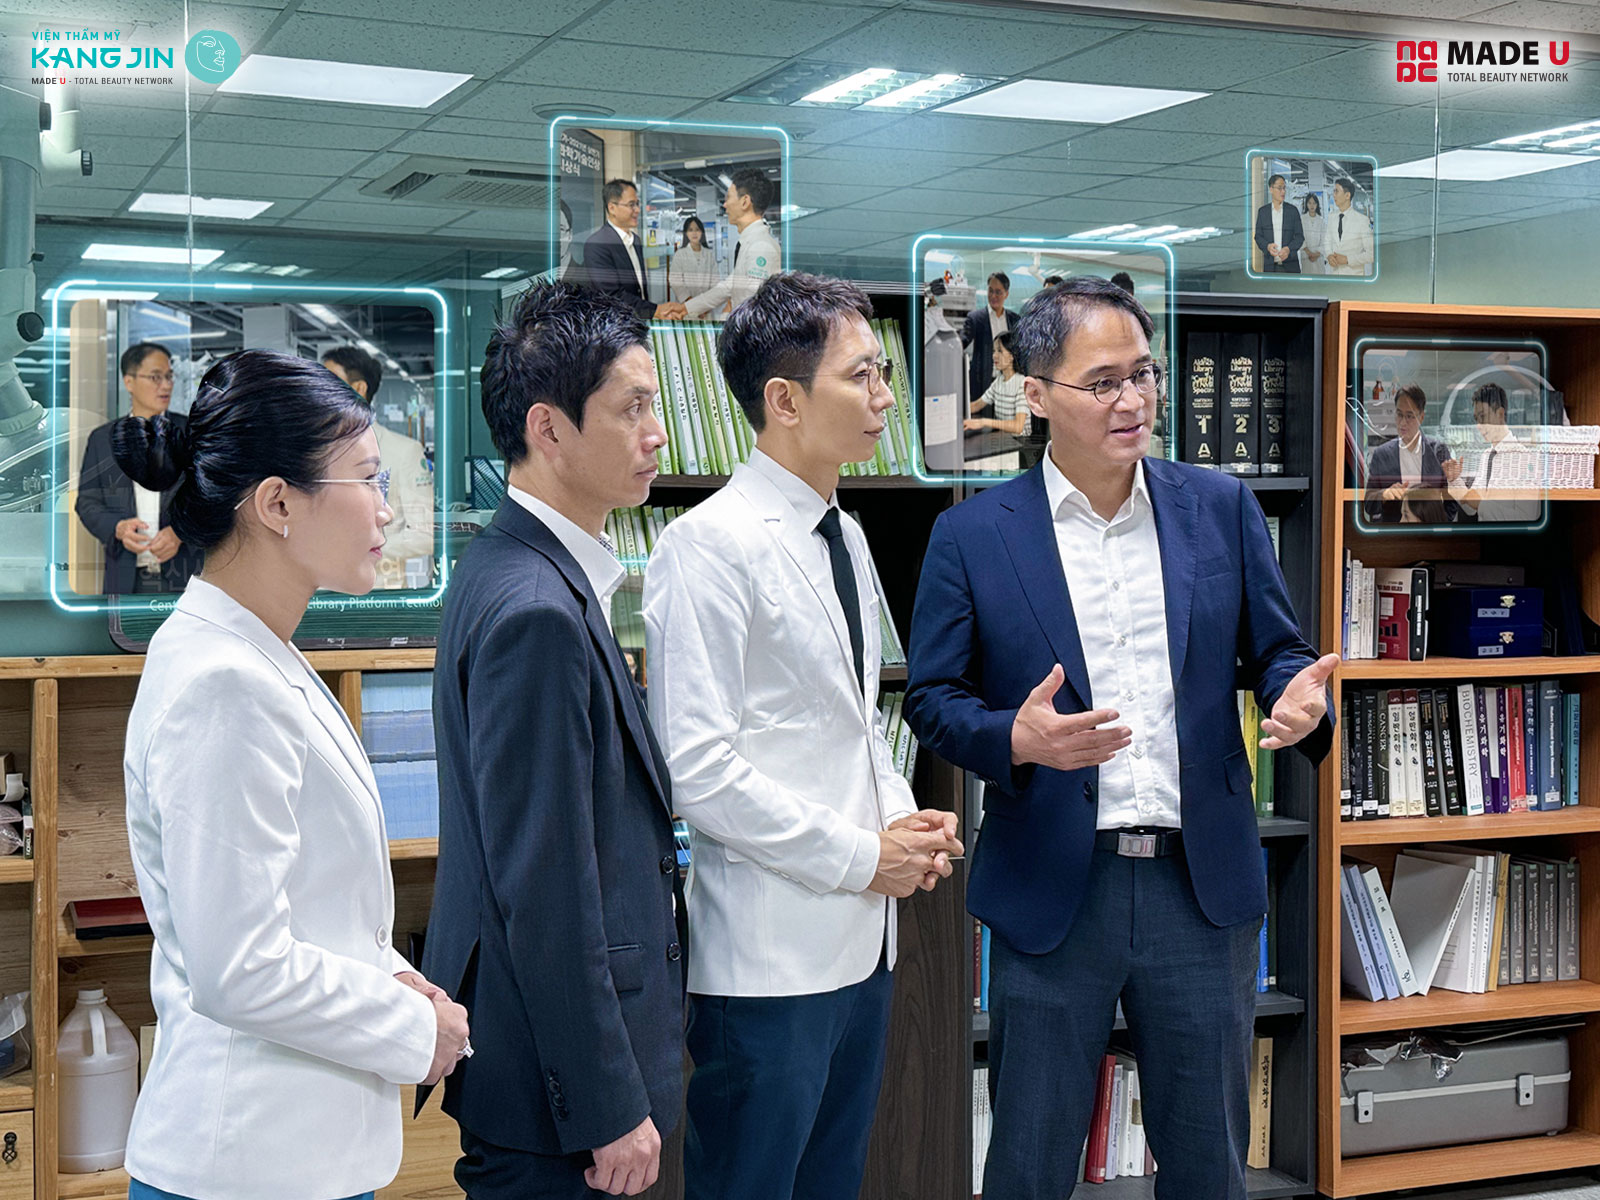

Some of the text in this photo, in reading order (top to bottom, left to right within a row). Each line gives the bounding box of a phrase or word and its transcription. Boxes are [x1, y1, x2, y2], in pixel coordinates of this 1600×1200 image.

[1198, 418, 1207, 434] 1
[1235, 417, 1247, 434] 2
[1268, 418, 1280, 434] 3
[627, 529, 637, 575] MICROWVE
[380, 555, 457, 591] 연구센
[149, 599, 177, 612] Cent
[307, 596, 346, 612] Library
[349, 596, 397, 609] Platform
[1379, 712, 1387, 751] CANCER
[1461, 689, 1478, 777] BIOCHEMISTRY
[1479, 713, 1489, 757] 유기화학
[1498, 713, 1507, 757] 유기화학
